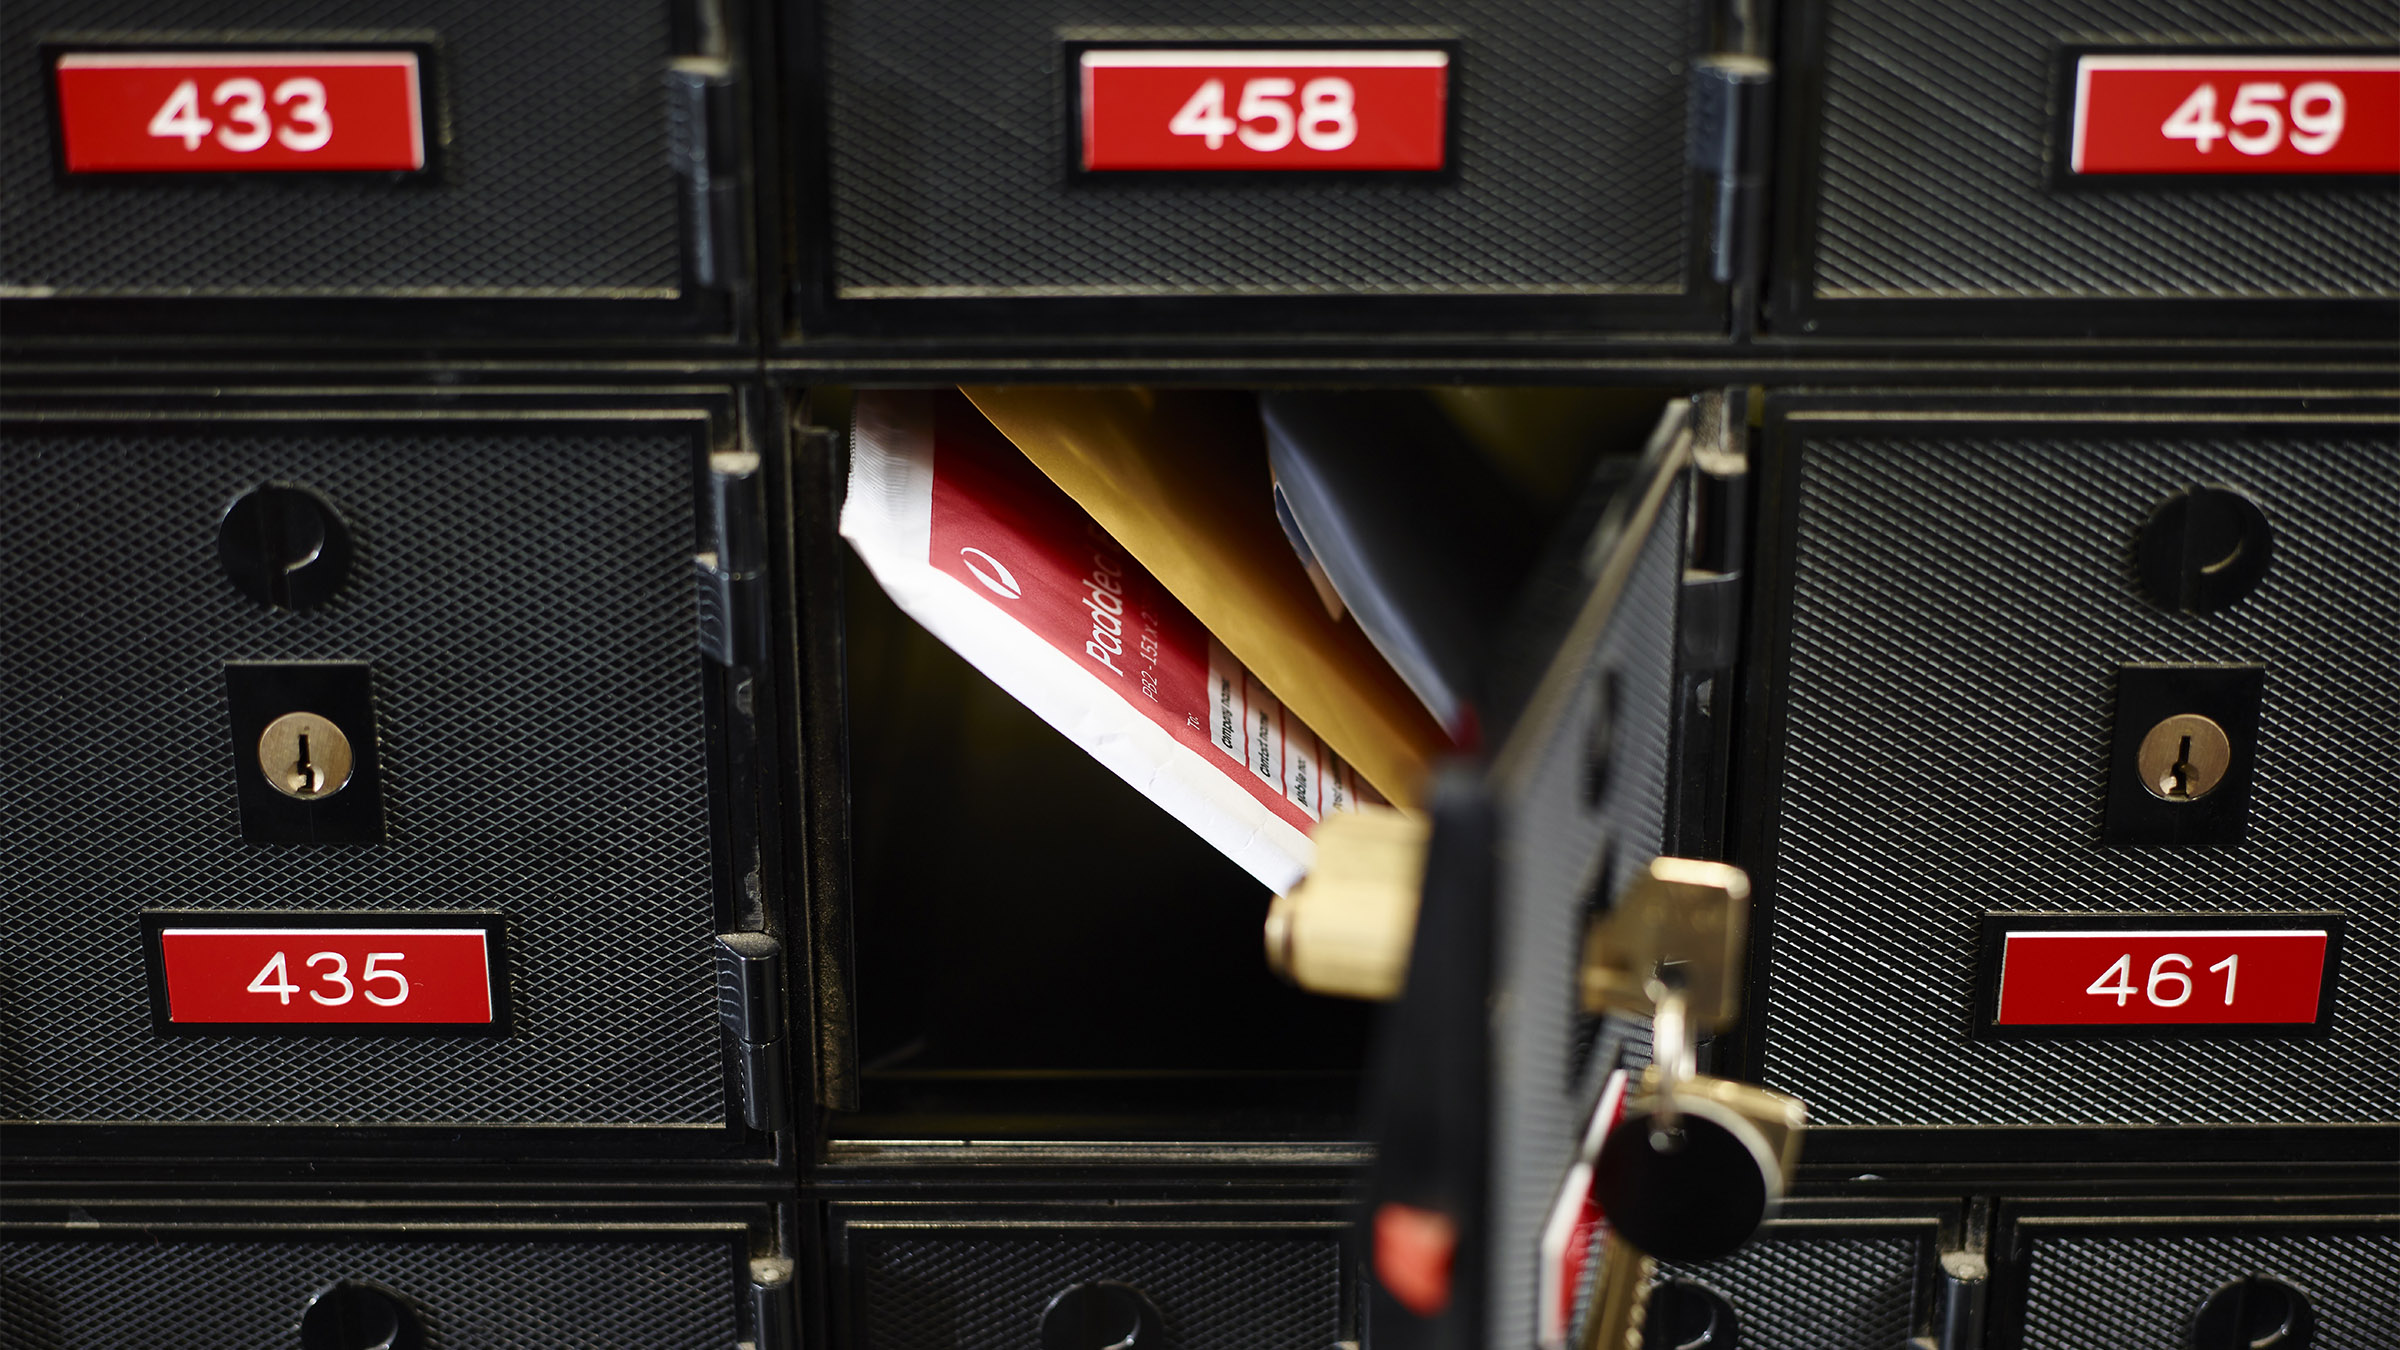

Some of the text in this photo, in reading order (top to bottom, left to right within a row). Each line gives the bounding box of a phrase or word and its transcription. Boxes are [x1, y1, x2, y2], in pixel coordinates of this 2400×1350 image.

[148, 77, 333, 152] 433
[1168, 77, 1358, 152] 458
[2160, 82, 2346, 155] 459
[1140, 634, 1158, 666] 151
[1141, 670, 1158, 703] PB2
[246, 951, 409, 1007] 435
[2085, 953, 2239, 1008] 461
